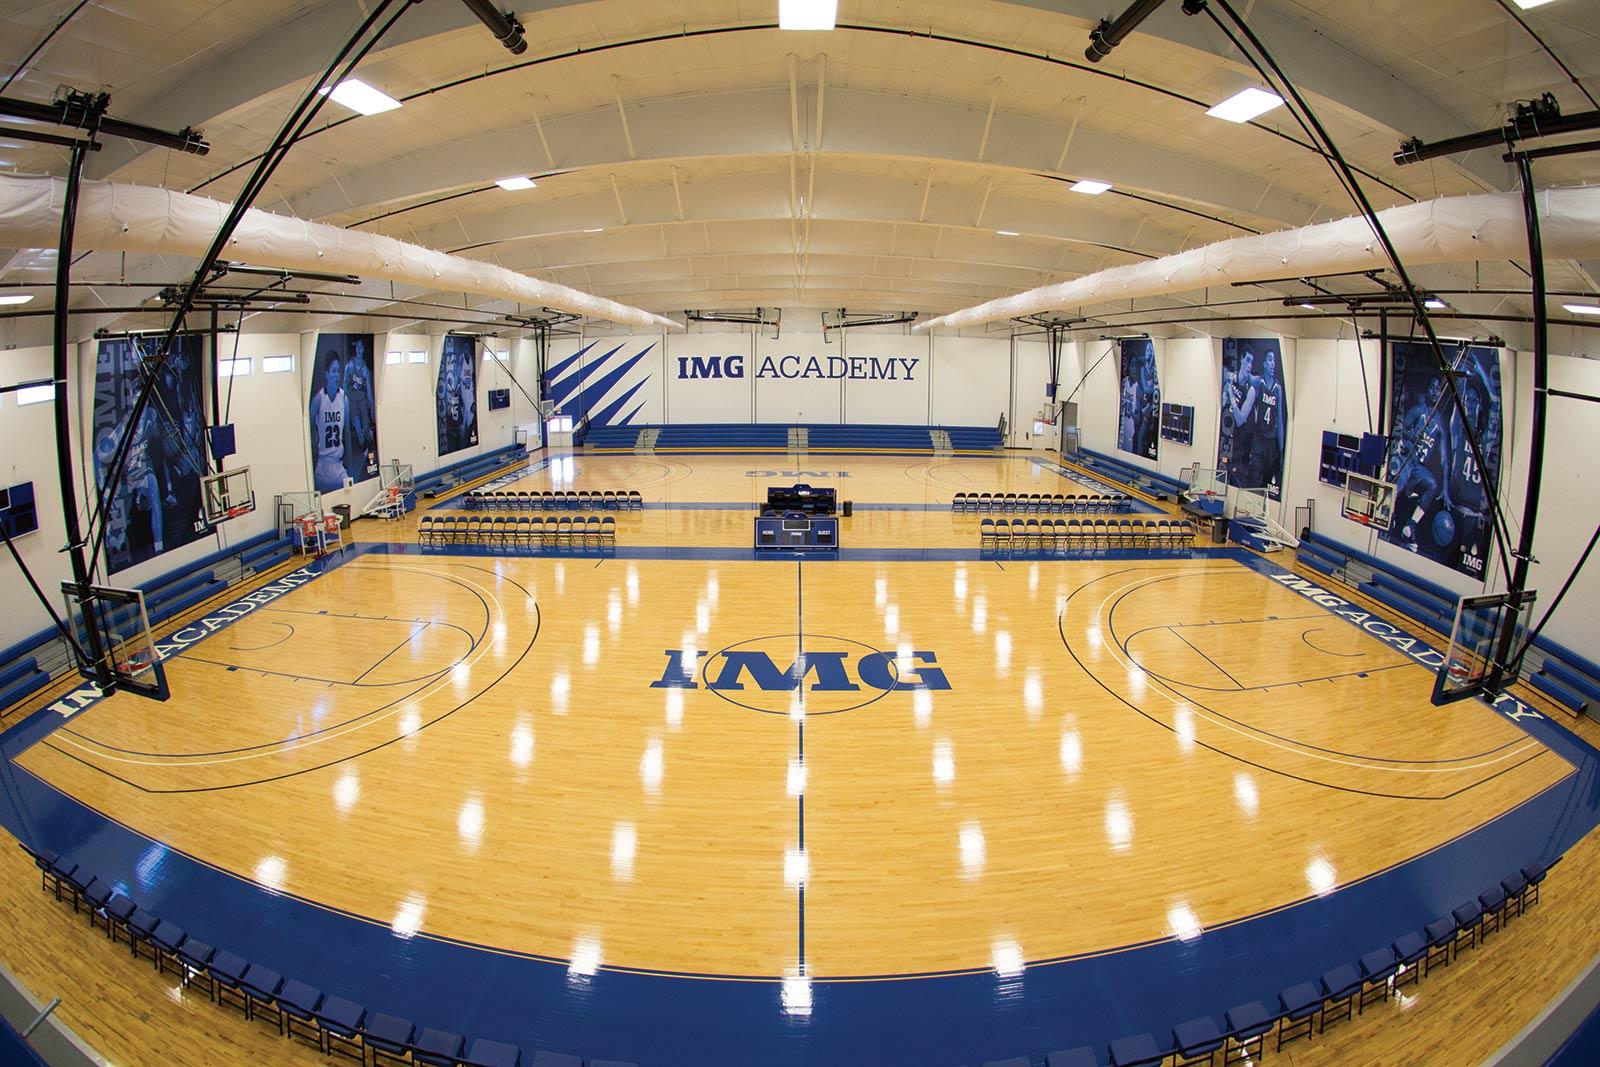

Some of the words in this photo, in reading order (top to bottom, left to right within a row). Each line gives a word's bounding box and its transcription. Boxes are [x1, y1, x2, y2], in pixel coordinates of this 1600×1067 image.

[677, 355, 744, 380] IMG
[756, 355, 920, 381] ACADEMY
[1262, 393, 1276, 406] IMG
[325, 411, 341, 423] IMG
[1263, 407, 1271, 425] 4
[325, 425, 341, 448] 23
[1462, 456, 1482, 484] 45
[1267, 483, 1280, 495] IMG
[193, 520, 206, 532] IM
[1462, 553, 1483, 572] IMG
[1269, 573, 1349, 608] IMG
[153, 567, 323, 661] ACADEMY
[649, 649, 953, 692] IMG
